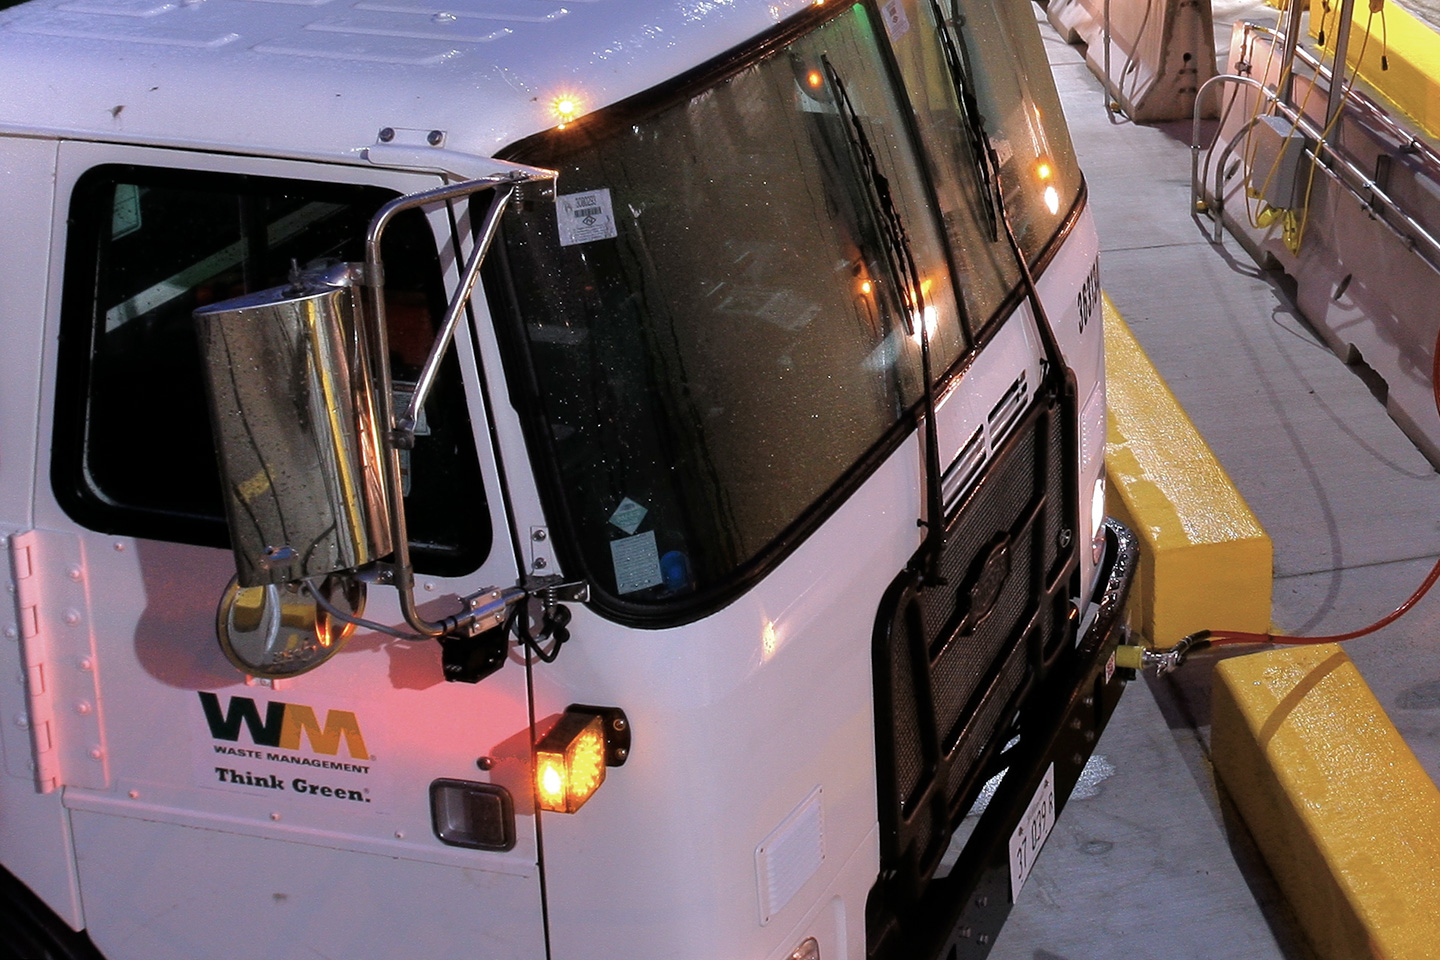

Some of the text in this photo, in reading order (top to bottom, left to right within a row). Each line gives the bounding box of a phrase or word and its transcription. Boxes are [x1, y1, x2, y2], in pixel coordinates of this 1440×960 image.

[197, 690, 370, 761] WM
[213, 745, 370, 774] WASTE MANAGEMENT
[214, 766, 371, 803] Think Green.
[1016, 835, 1028, 880] 37
